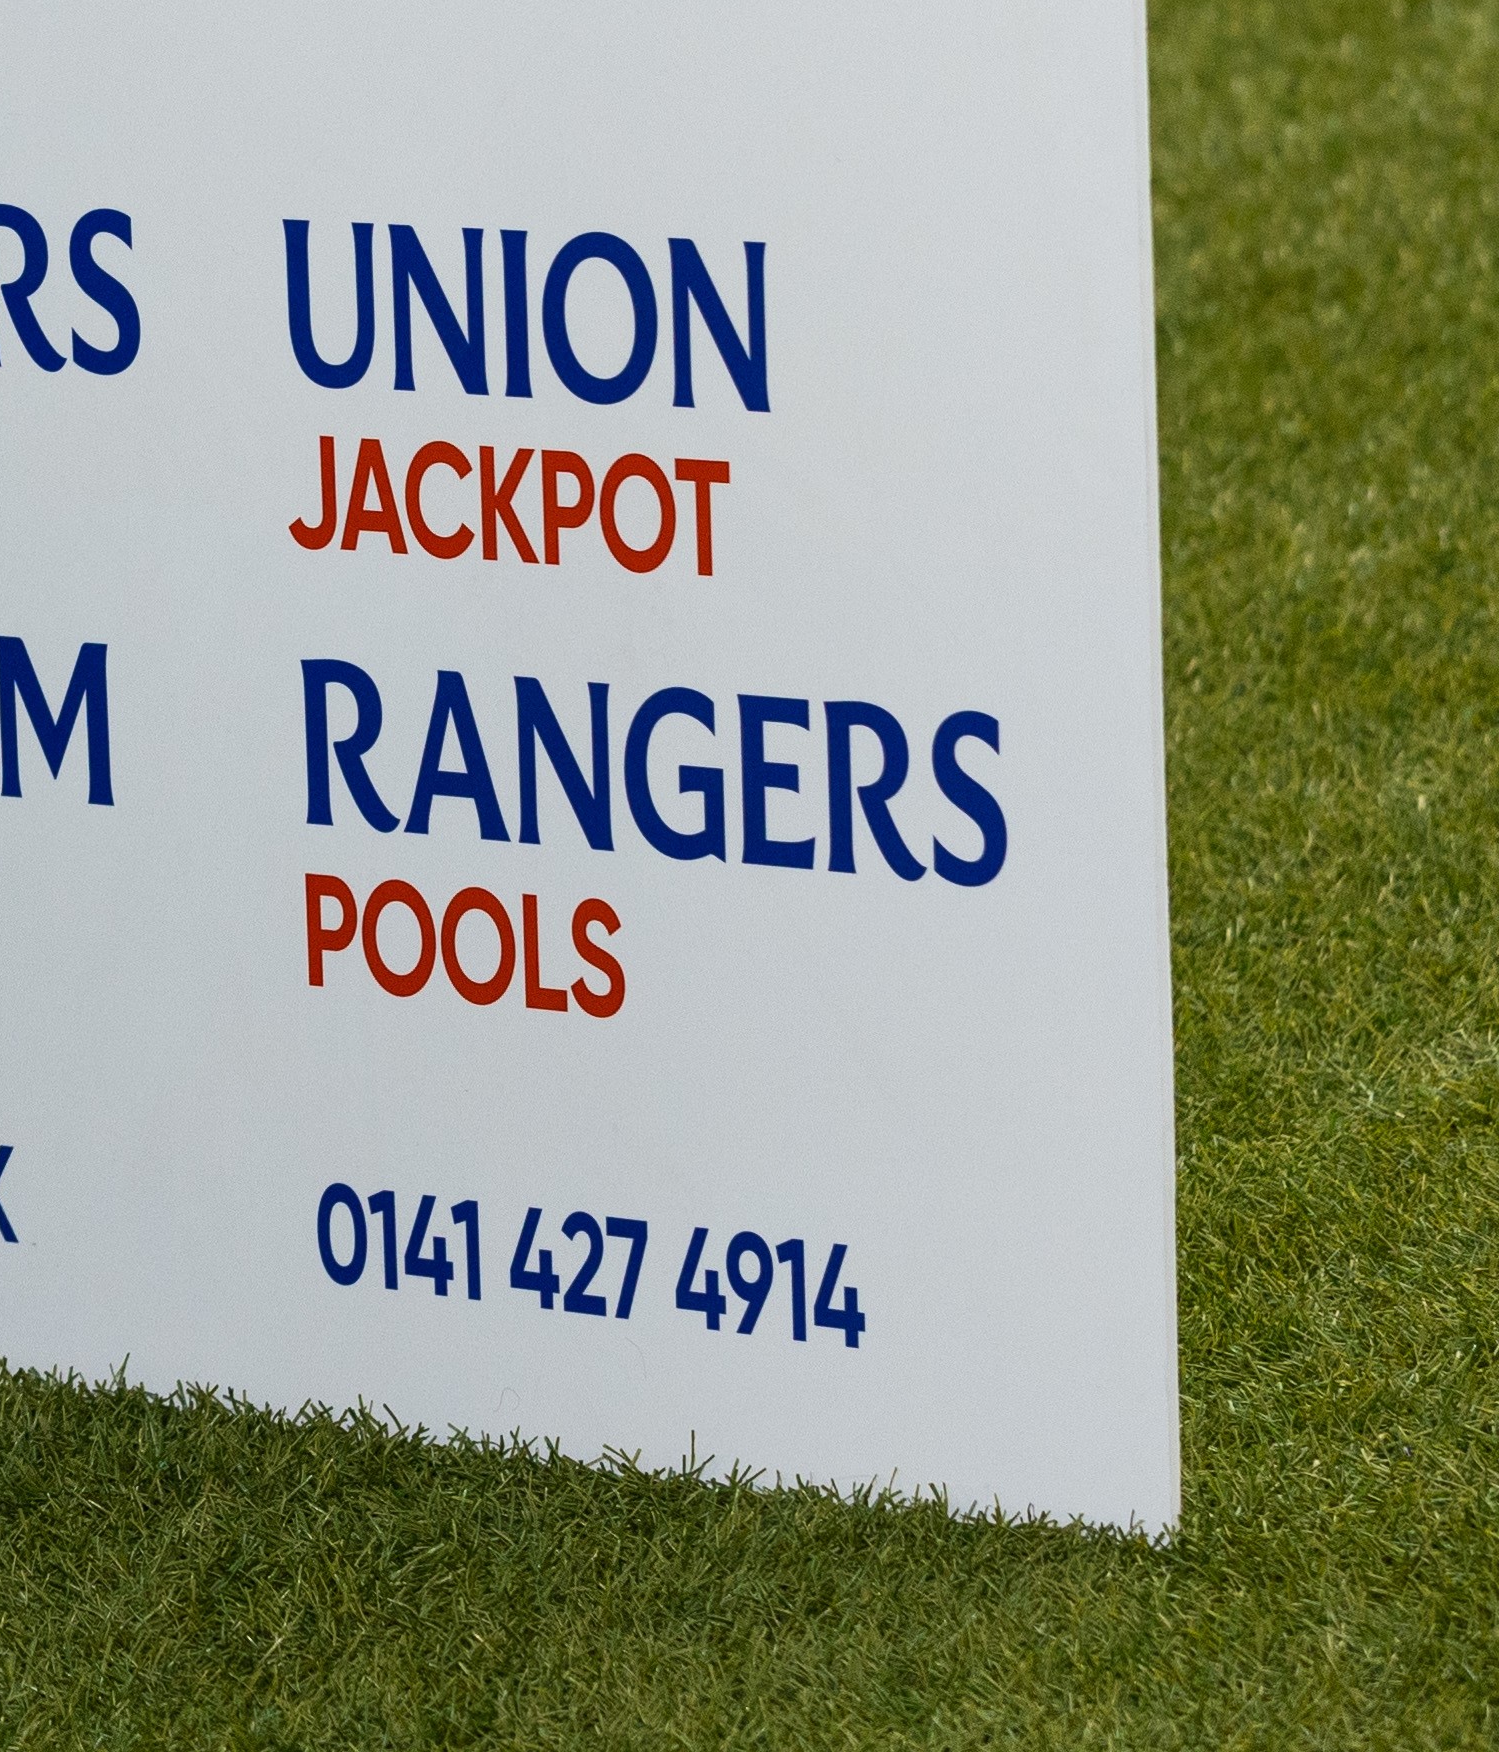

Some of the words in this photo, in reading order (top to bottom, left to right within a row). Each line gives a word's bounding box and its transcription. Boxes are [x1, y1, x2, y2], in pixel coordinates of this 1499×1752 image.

[283, 220, 770, 413] UNION
[290, 436, 731, 577] JACKPOT
[301, 659, 1008, 887] RANGERS
[306, 874, 626, 1019] POOLS
[318, 1183, 481, 1301] 0141
[510, 1208, 648, 1320] 427
[676, 1228, 866, 1349] 4914
